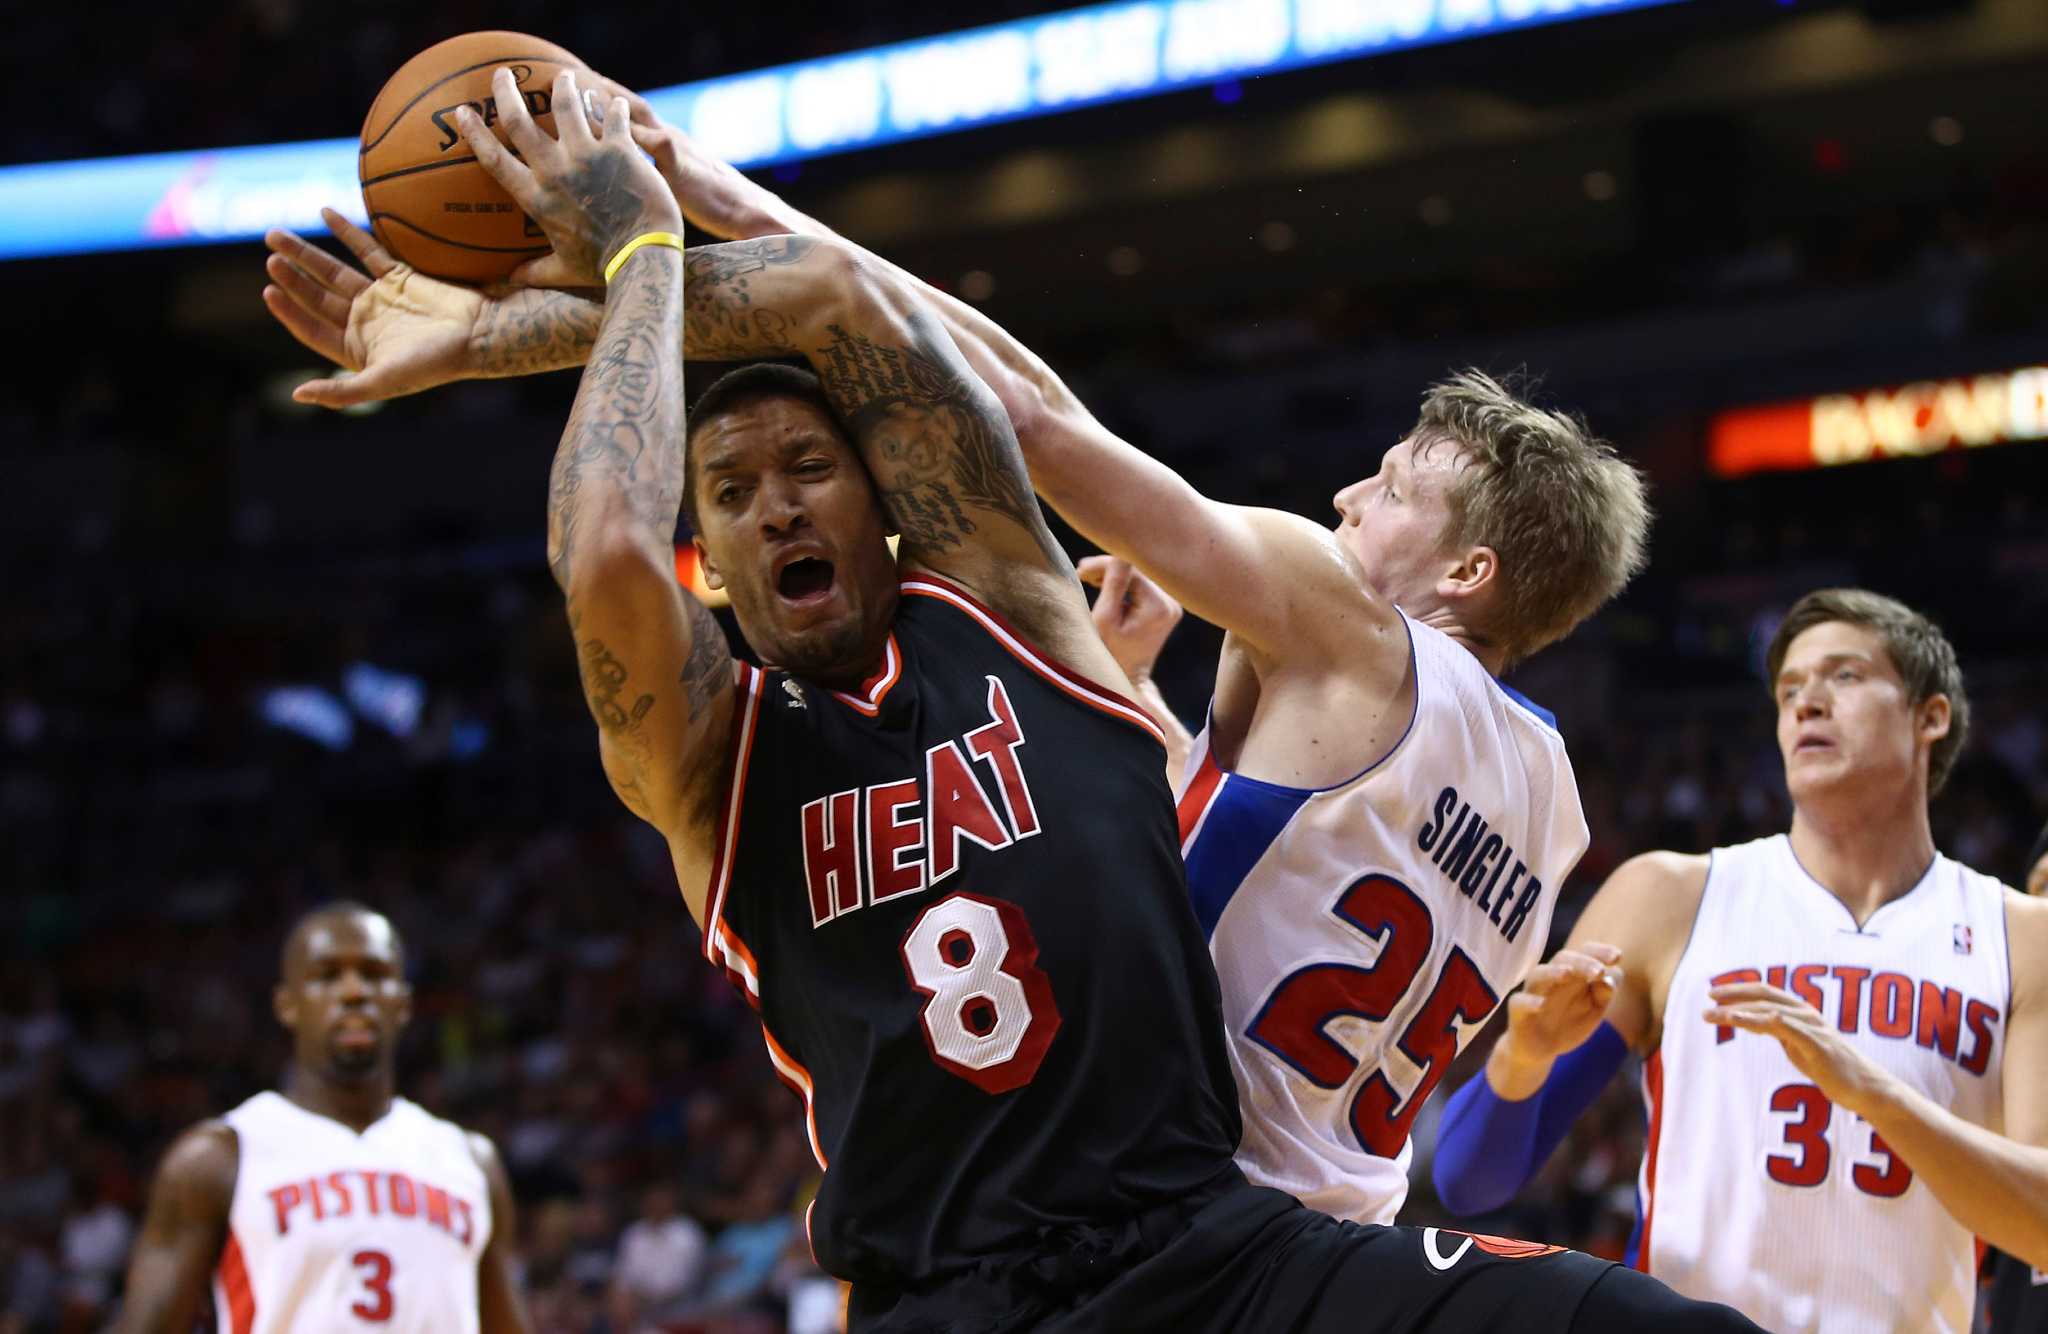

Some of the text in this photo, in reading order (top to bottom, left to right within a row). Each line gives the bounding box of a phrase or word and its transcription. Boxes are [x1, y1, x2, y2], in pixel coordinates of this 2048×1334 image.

[800, 674, 1042, 929] HEAT
[1417, 786, 1542, 943] SINGLER
[899, 890, 1062, 1095] 8
[1244, 871, 1500, 1160] 25
[266, 1170, 475, 1246] PISTONS
[351, 1249, 395, 1323] 3
